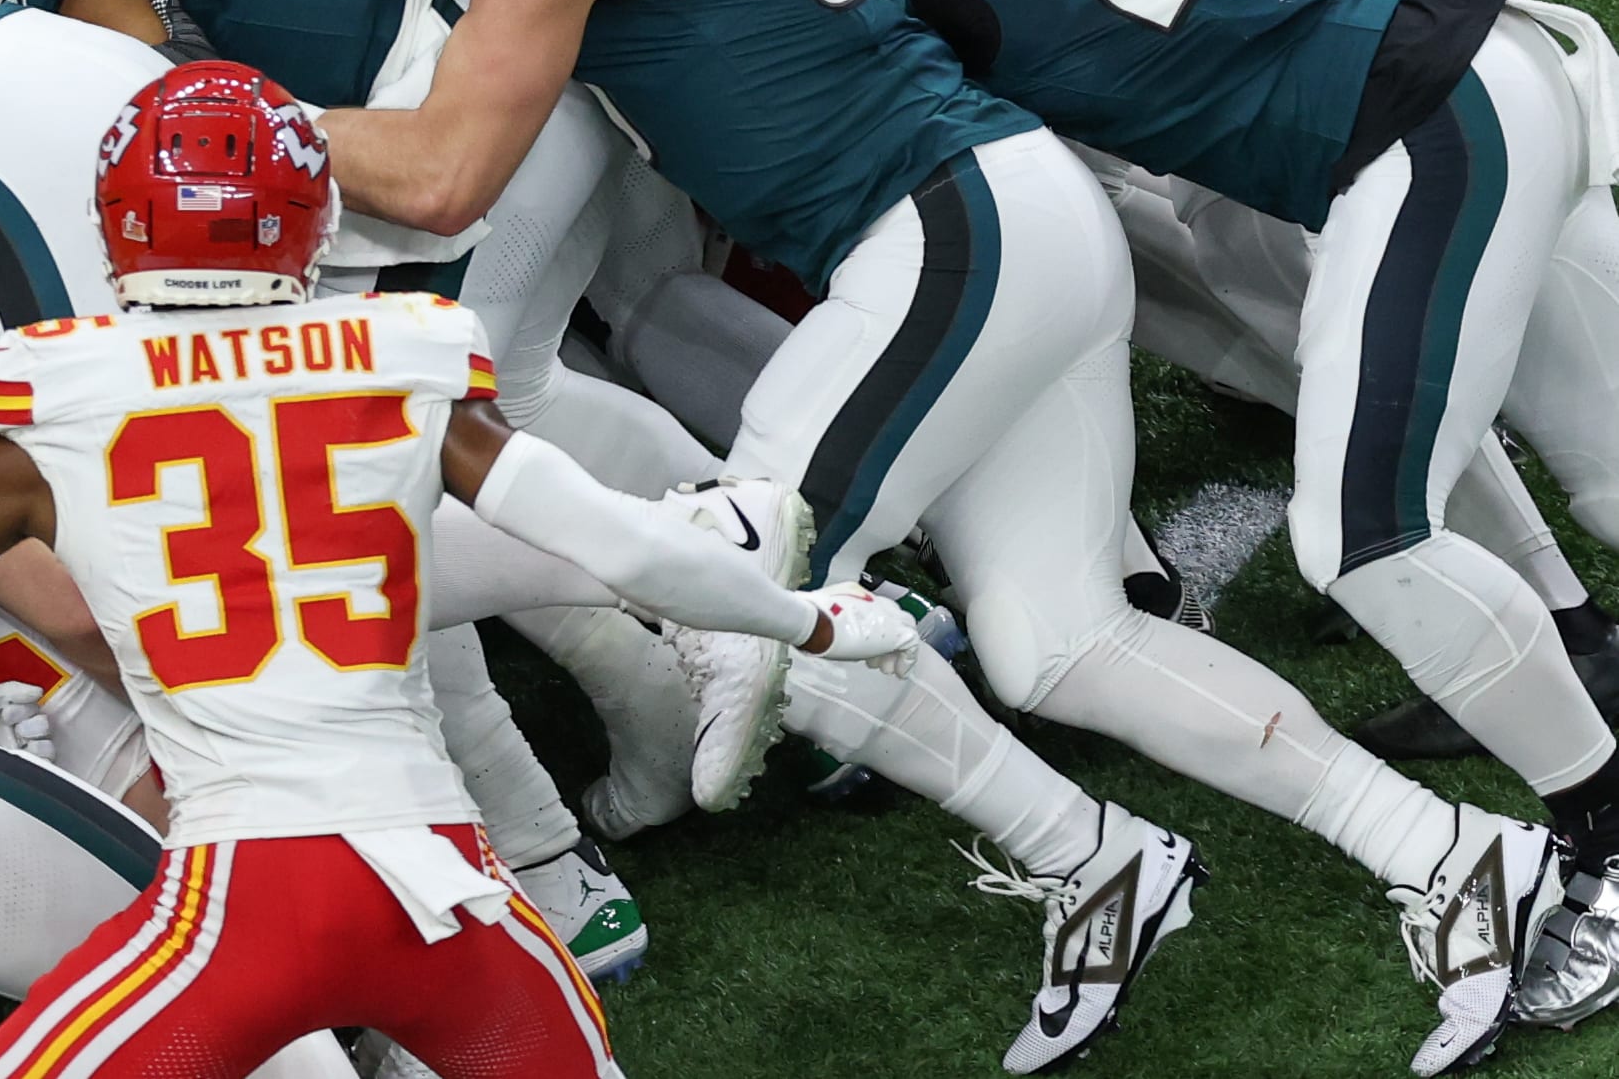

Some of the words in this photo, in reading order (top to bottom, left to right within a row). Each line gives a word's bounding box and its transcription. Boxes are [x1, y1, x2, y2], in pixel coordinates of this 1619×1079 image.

[164, 278, 208, 289] CHOOSE
[212, 278, 242, 289] LOVE
[140, 317, 377, 389] WATSON
[105, 390, 420, 694] 35
[1098, 899, 1120, 961] ALPHA
[1477, 884, 1491, 946] ALPHA
